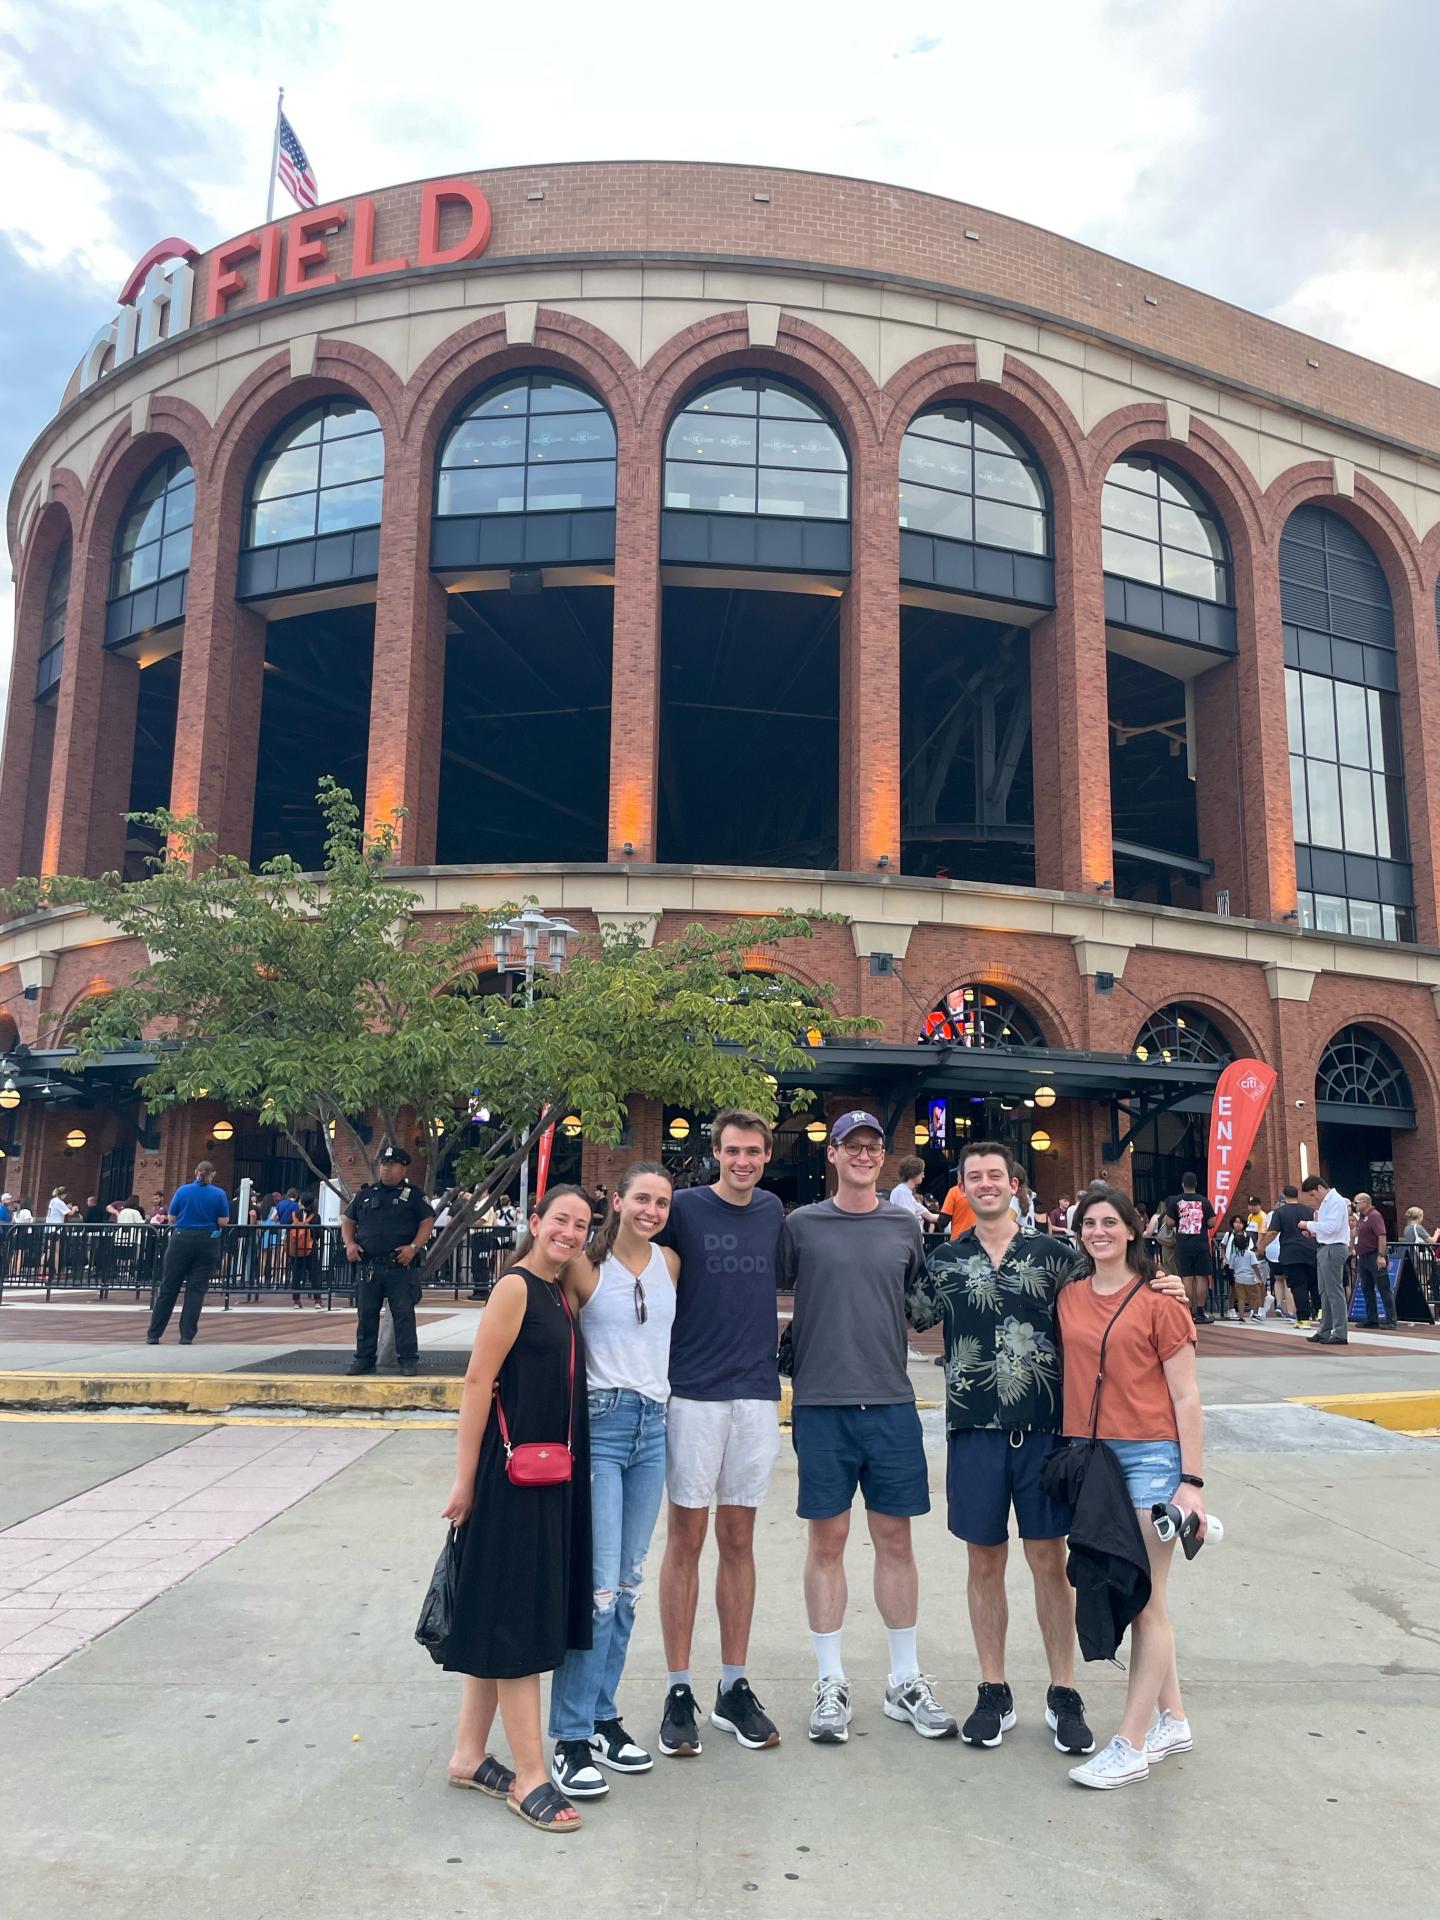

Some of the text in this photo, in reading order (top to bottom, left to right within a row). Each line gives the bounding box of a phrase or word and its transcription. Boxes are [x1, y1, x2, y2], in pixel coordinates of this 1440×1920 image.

[79, 179, 491, 394] citi FIELD
[1241, 1076, 1257, 1088] citi
[1214, 1096, 1232, 1215] ENTER
[704, 1234, 738, 1250] DO
